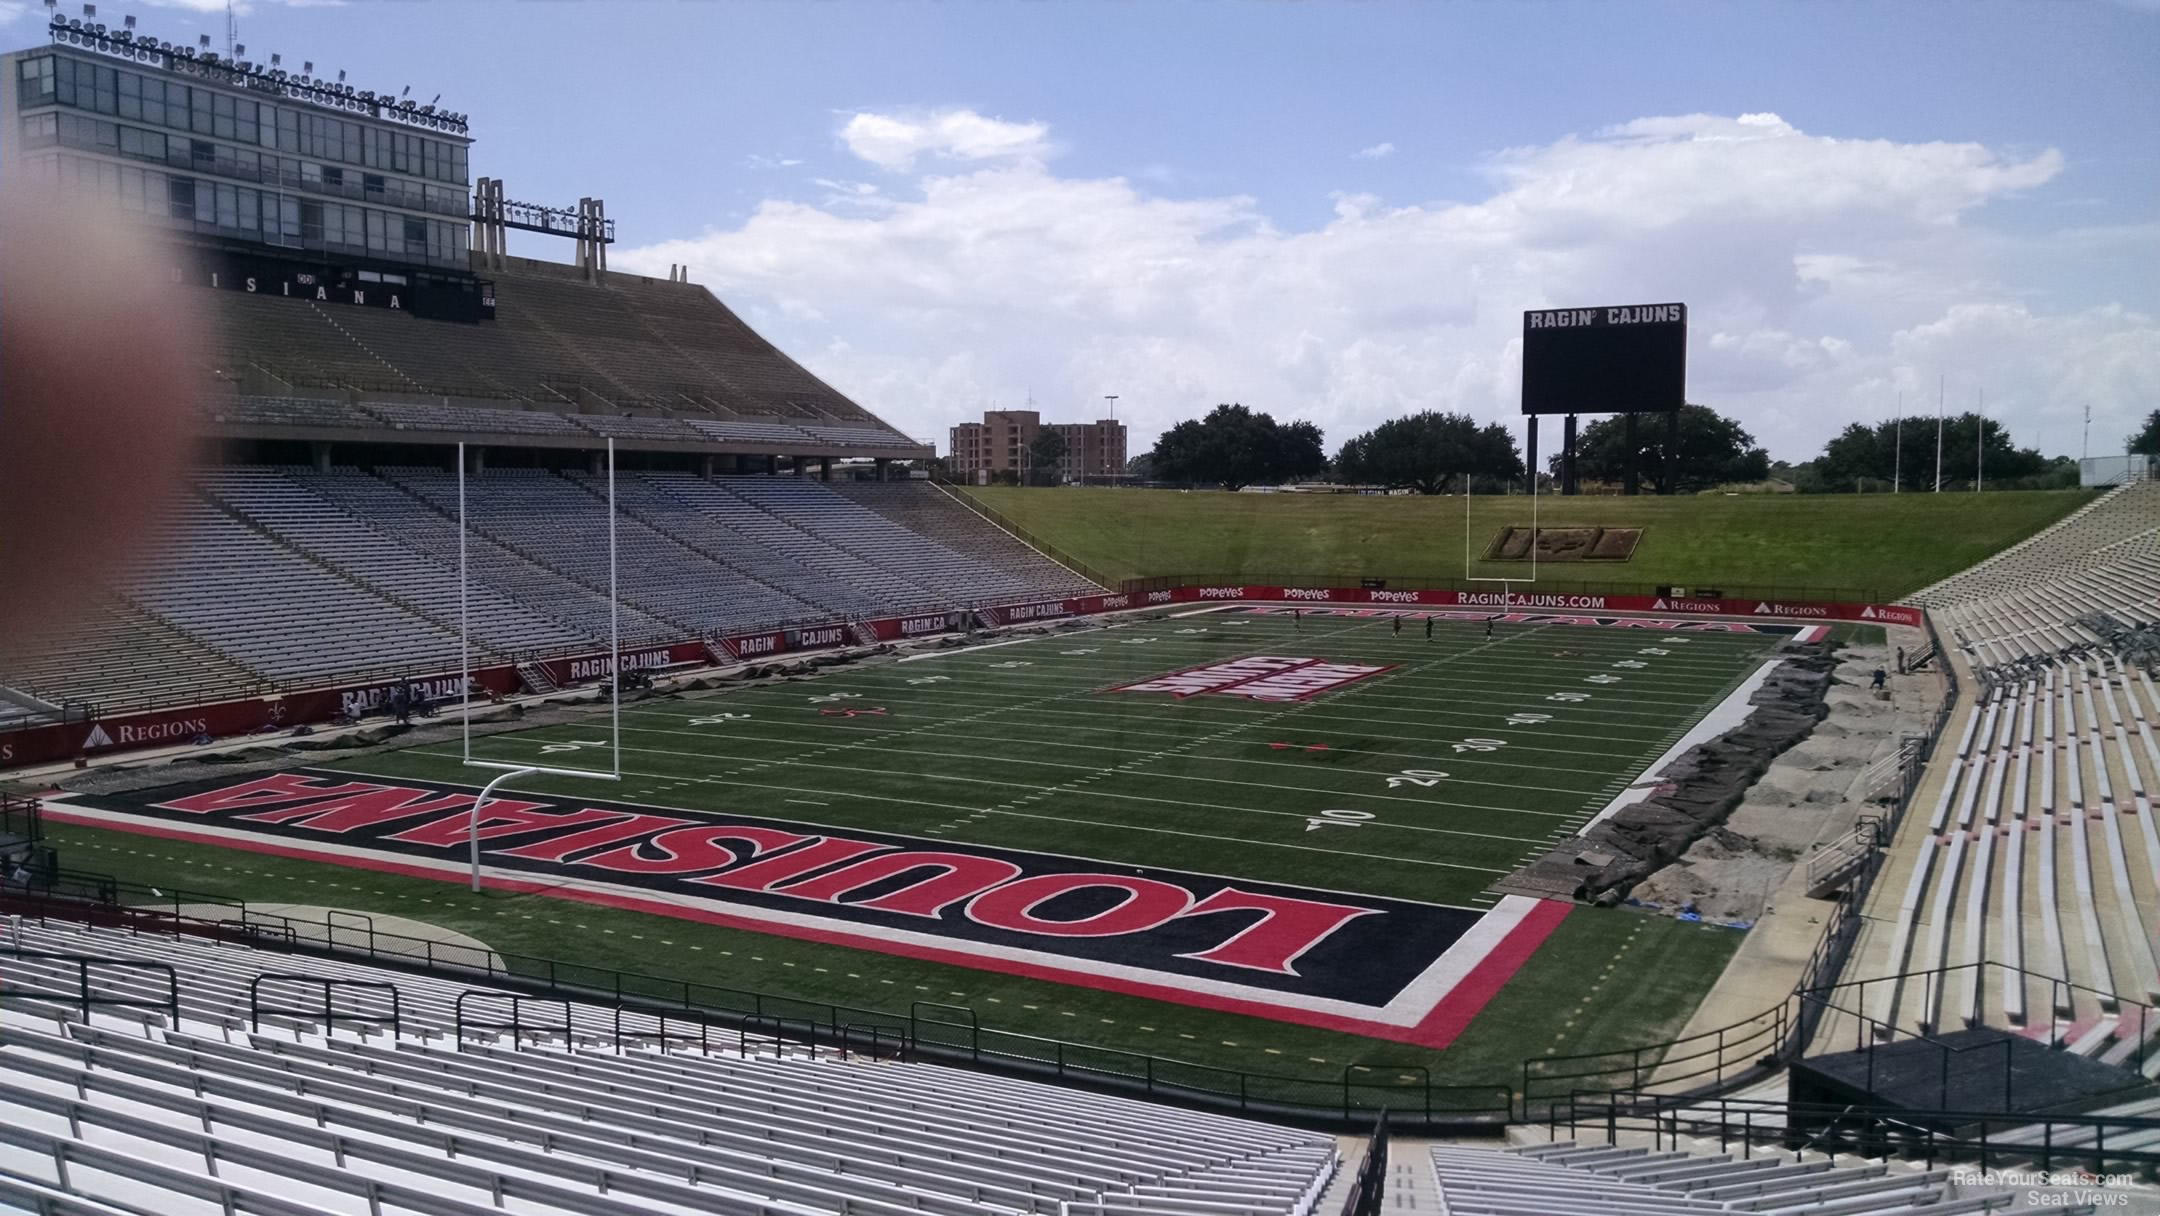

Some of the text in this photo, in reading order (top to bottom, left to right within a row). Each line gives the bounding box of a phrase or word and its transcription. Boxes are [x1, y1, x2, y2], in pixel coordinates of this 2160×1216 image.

[1607, 305, 1680, 324] CAJUNS
[1458, 592, 1605, 608] RAGINCAJUNS.COM
[1671, 601, 1720, 612] REGIONS
[1036, 603, 1064, 616] CAJUNS
[1774, 604, 1827, 616] REGIONS
[1878, 609, 1912, 622] REGIONS
[801, 628, 843, 646] CAJUNS
[621, 650, 670, 672] CAJUNS
[1546, 692, 1593, 702] 50
[688, 713, 752, 725] 20
[1506, 713, 1553, 724] 40
[120, 718, 207, 743] REGIONS
[541, 740, 608, 752] 10
[1451, 738, 1508, 751] 30
[1386, 769, 1450, 787] 20
[1306, 809, 1377, 828] 10
[146, 773, 1389, 977] LOUISIANA
